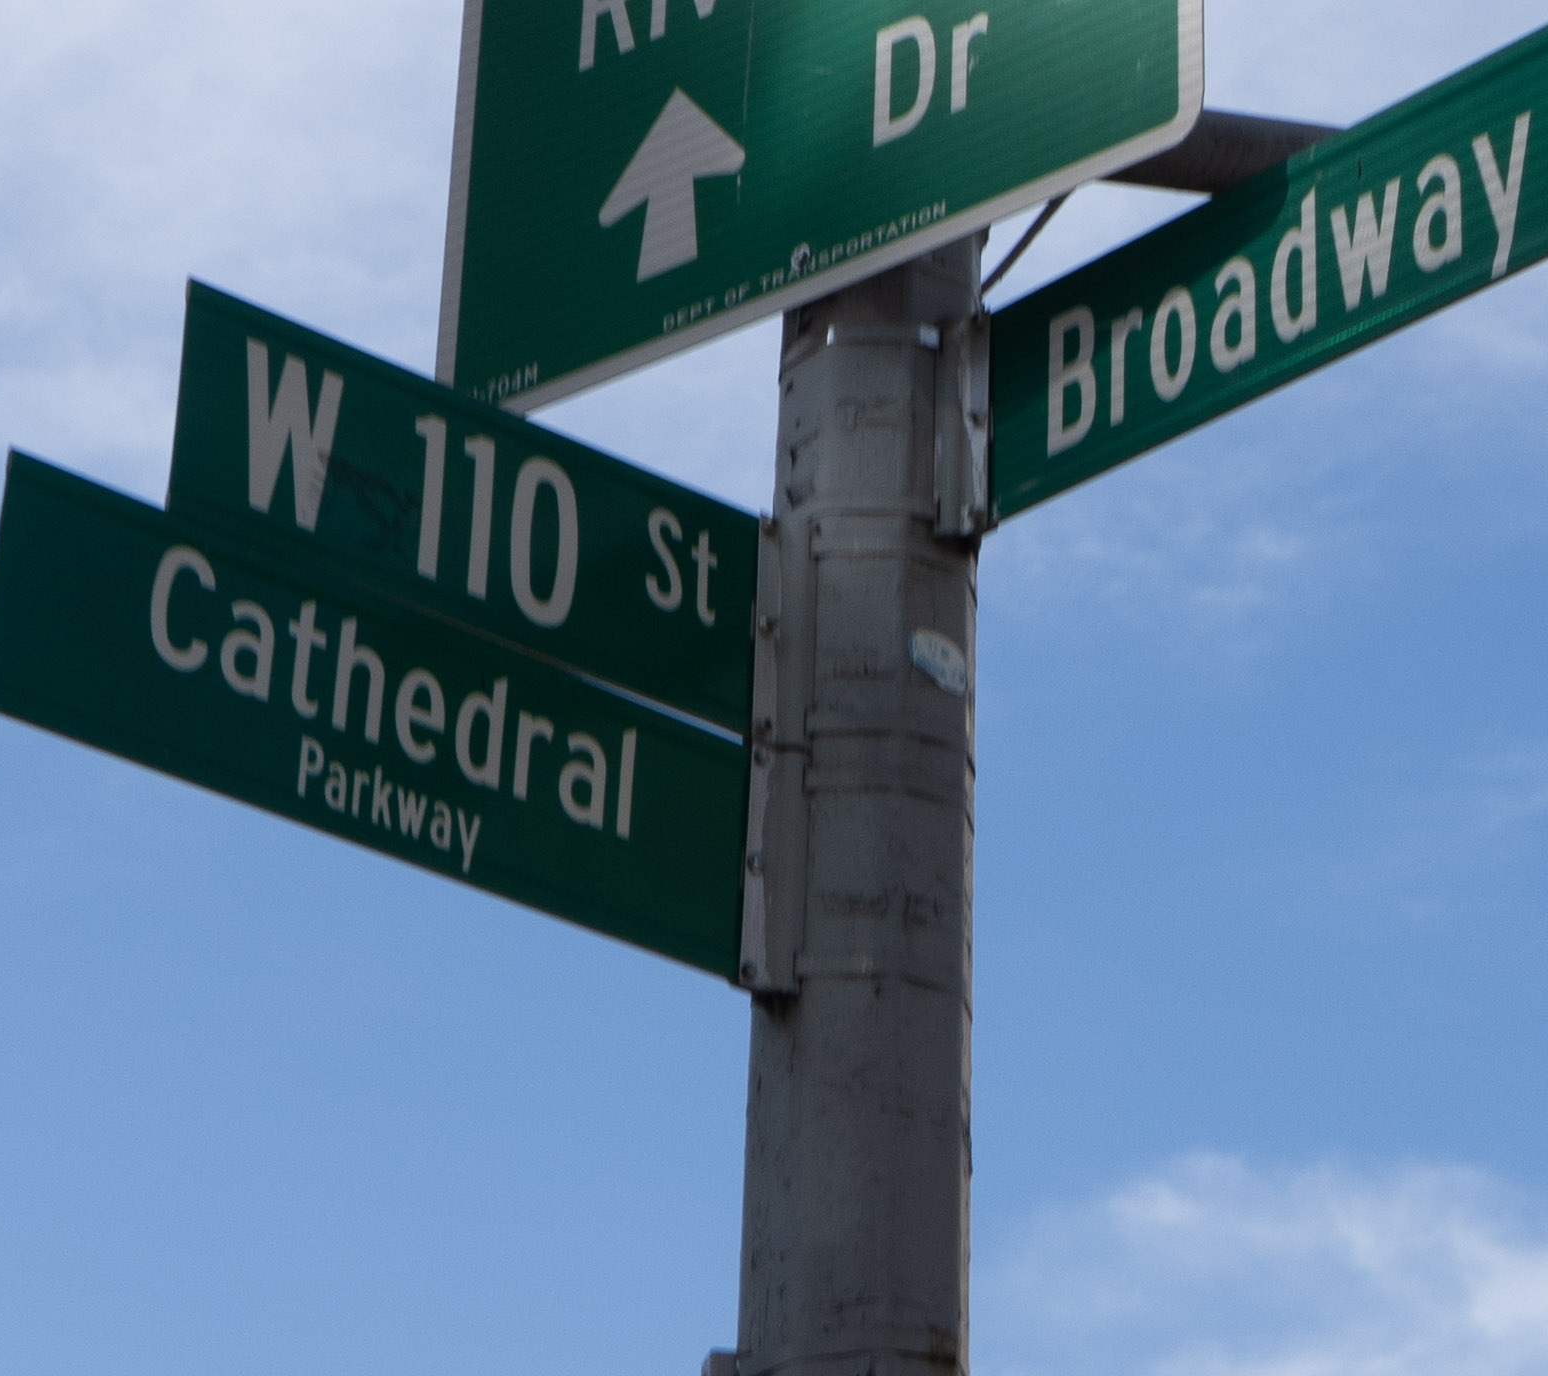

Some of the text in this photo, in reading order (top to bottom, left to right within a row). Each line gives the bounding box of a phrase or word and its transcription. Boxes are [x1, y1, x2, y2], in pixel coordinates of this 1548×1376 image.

[872, 12, 989, 148] Dr
[662, 199, 947, 334] DEPT OF TRANSPORTATION
[1046, 110, 1532, 458] Broadway
[246, 335, 719, 629] W 110 St
[149, 544, 638, 840] Cathedral
[296, 736, 481, 873] Parkway
